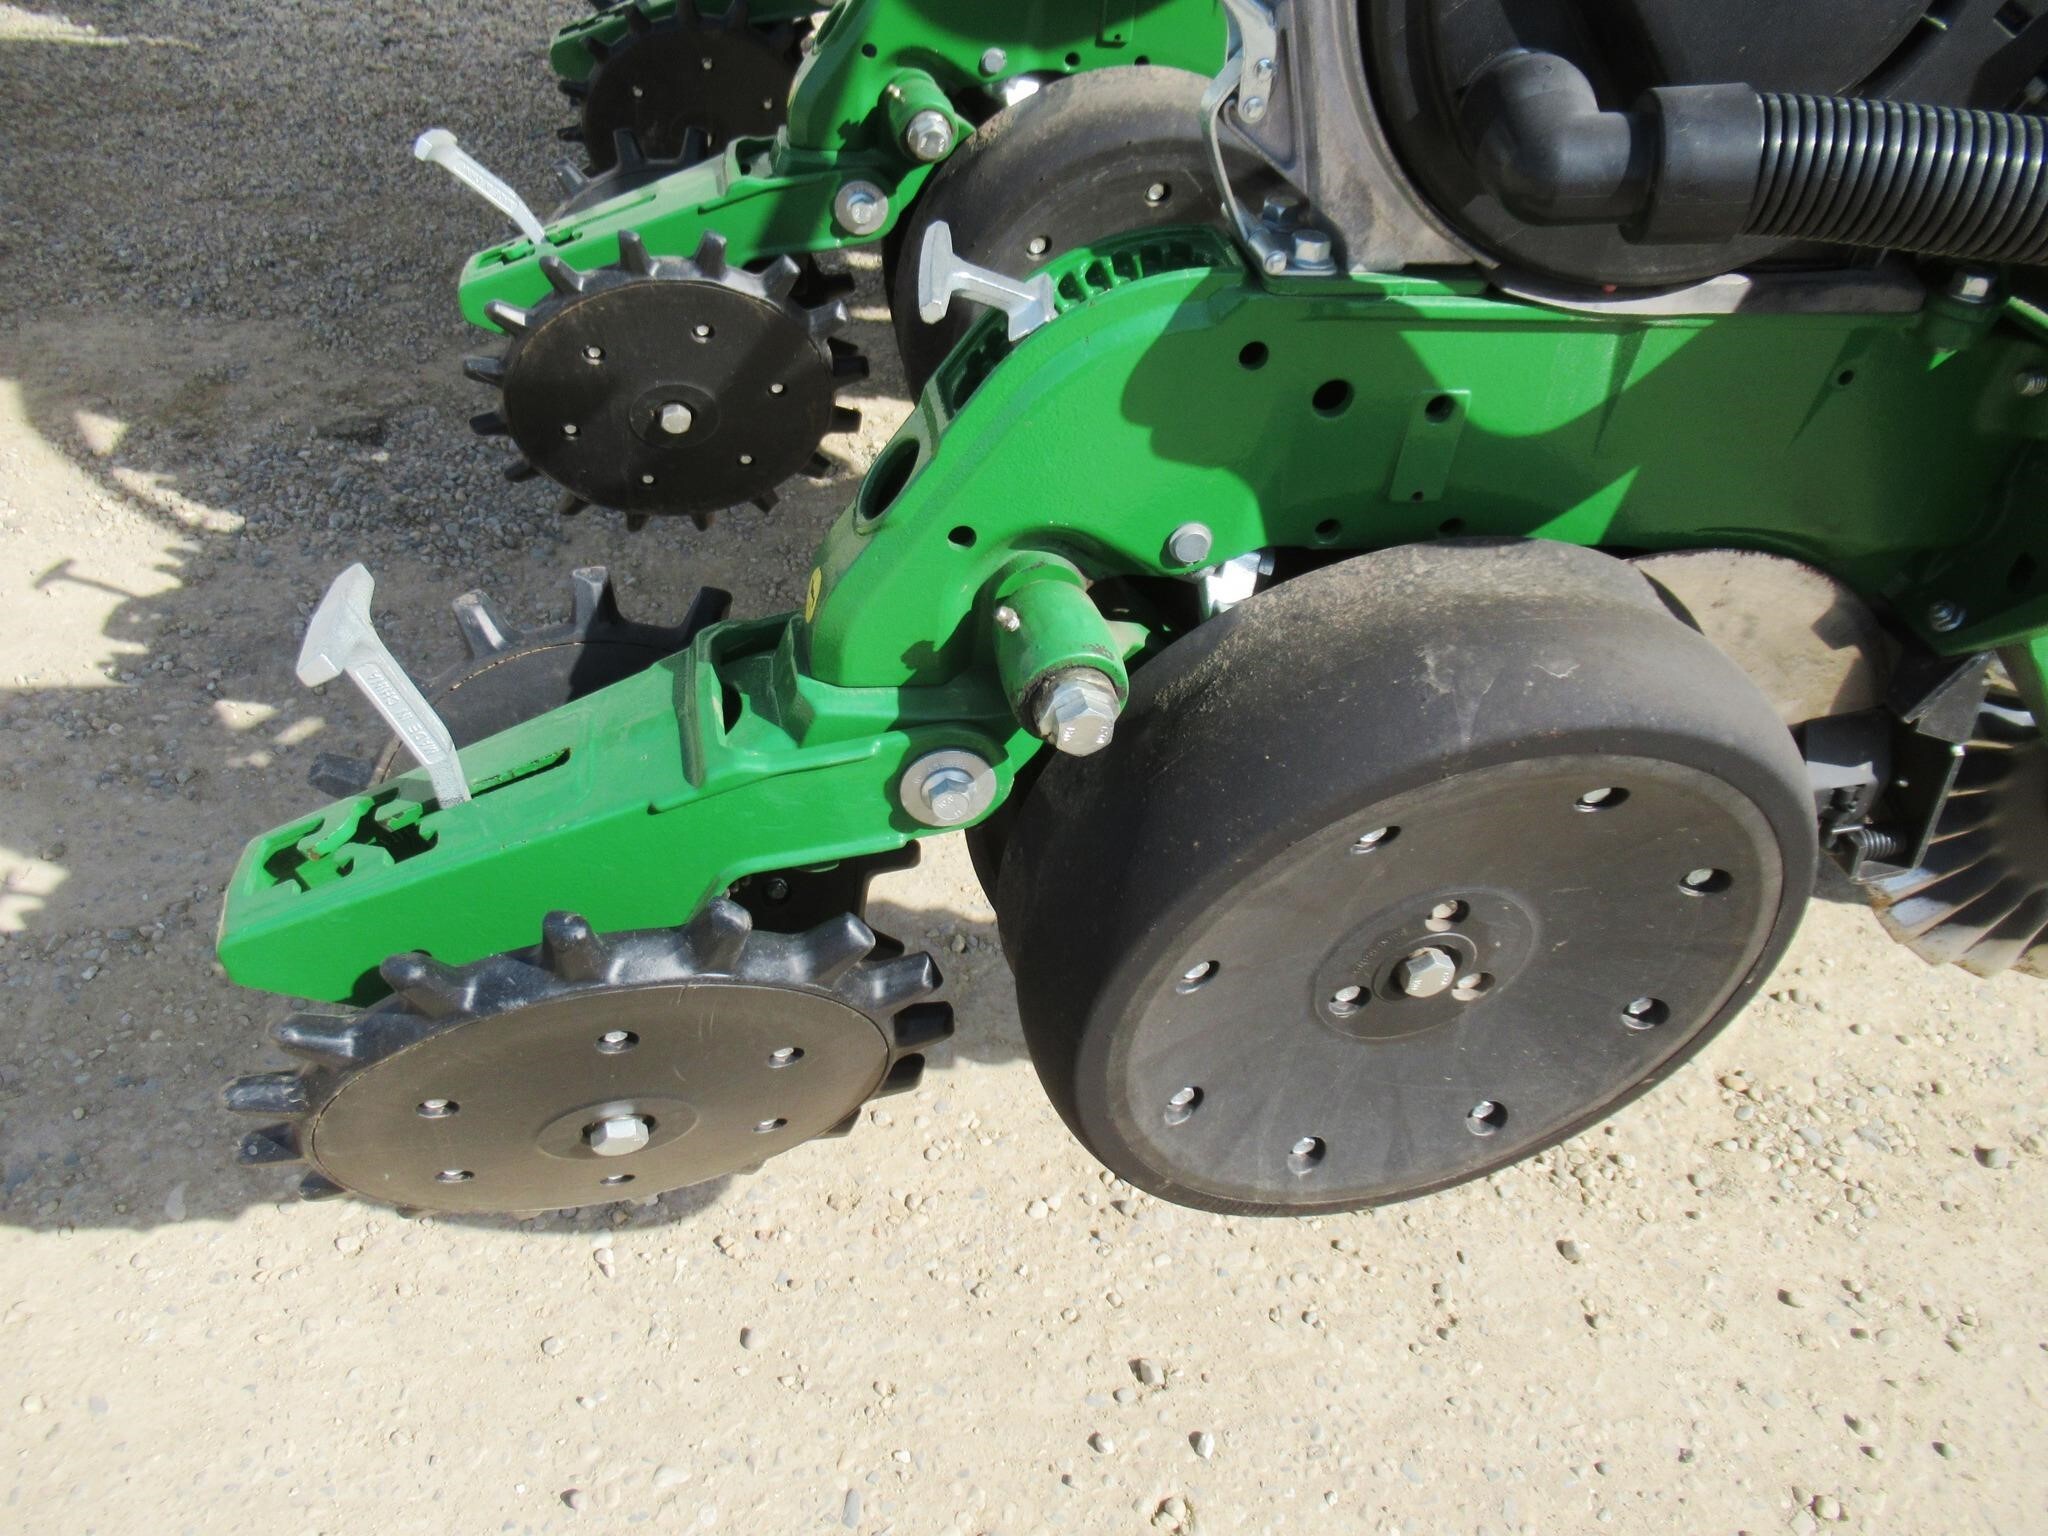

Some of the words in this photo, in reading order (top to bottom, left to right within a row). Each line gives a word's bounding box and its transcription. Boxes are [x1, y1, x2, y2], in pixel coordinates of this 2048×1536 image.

[368, 670, 400, 706] CHINA
[396, 708, 413, 722] IN
[408, 722, 440, 755] MADE
